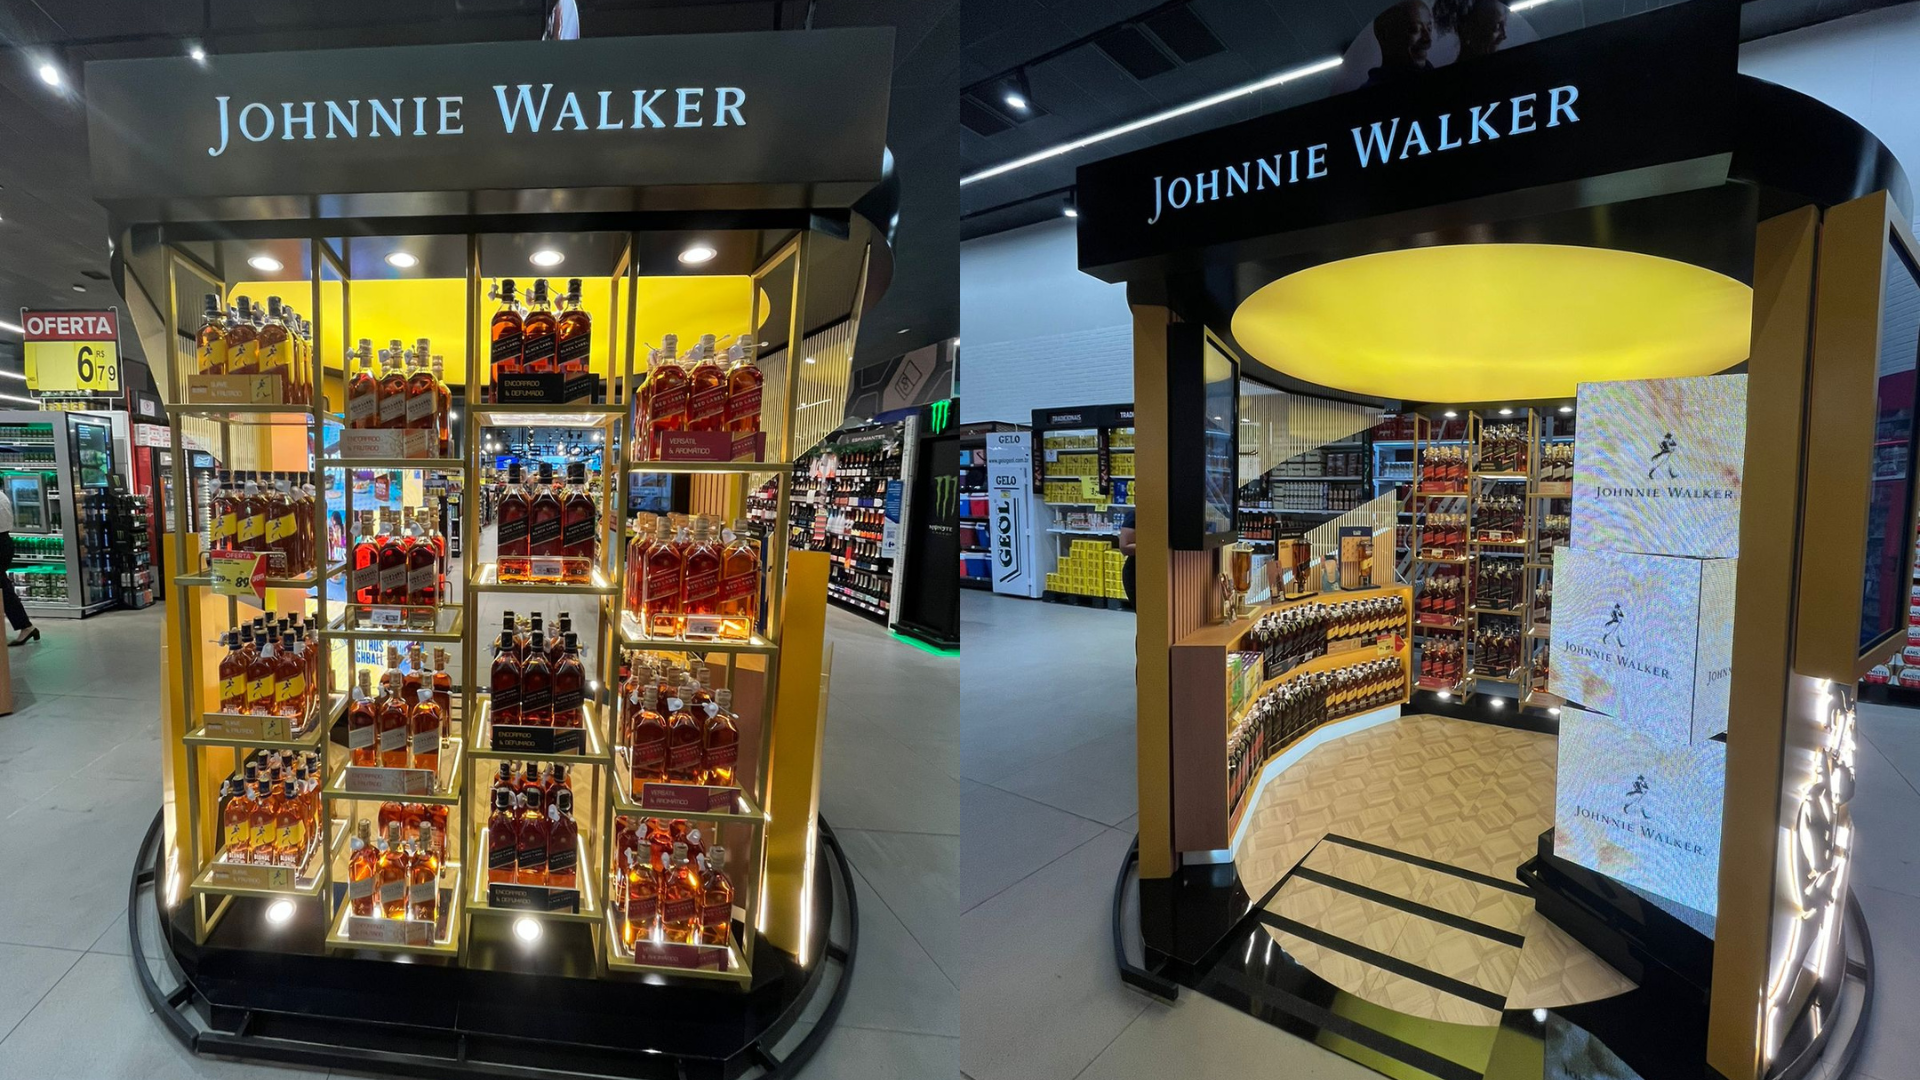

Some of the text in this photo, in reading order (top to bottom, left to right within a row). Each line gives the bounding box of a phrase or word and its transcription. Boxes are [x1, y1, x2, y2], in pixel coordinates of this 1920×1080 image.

[208, 83, 748, 157] JOHNNIE WALKER
[1148, 85, 1580, 225] JOHNNIE WALKER
[27, 316, 112, 335] OFERTA
[77, 346, 94, 382] 6
[998, 435, 1020, 444] GELO
[996, 476, 1017, 485] GELO
[1595, 486, 1661, 499] JOHNNIE
[997, 501, 1012, 567] GEOL
[1564, 641, 1612, 662] JOHNNIE
